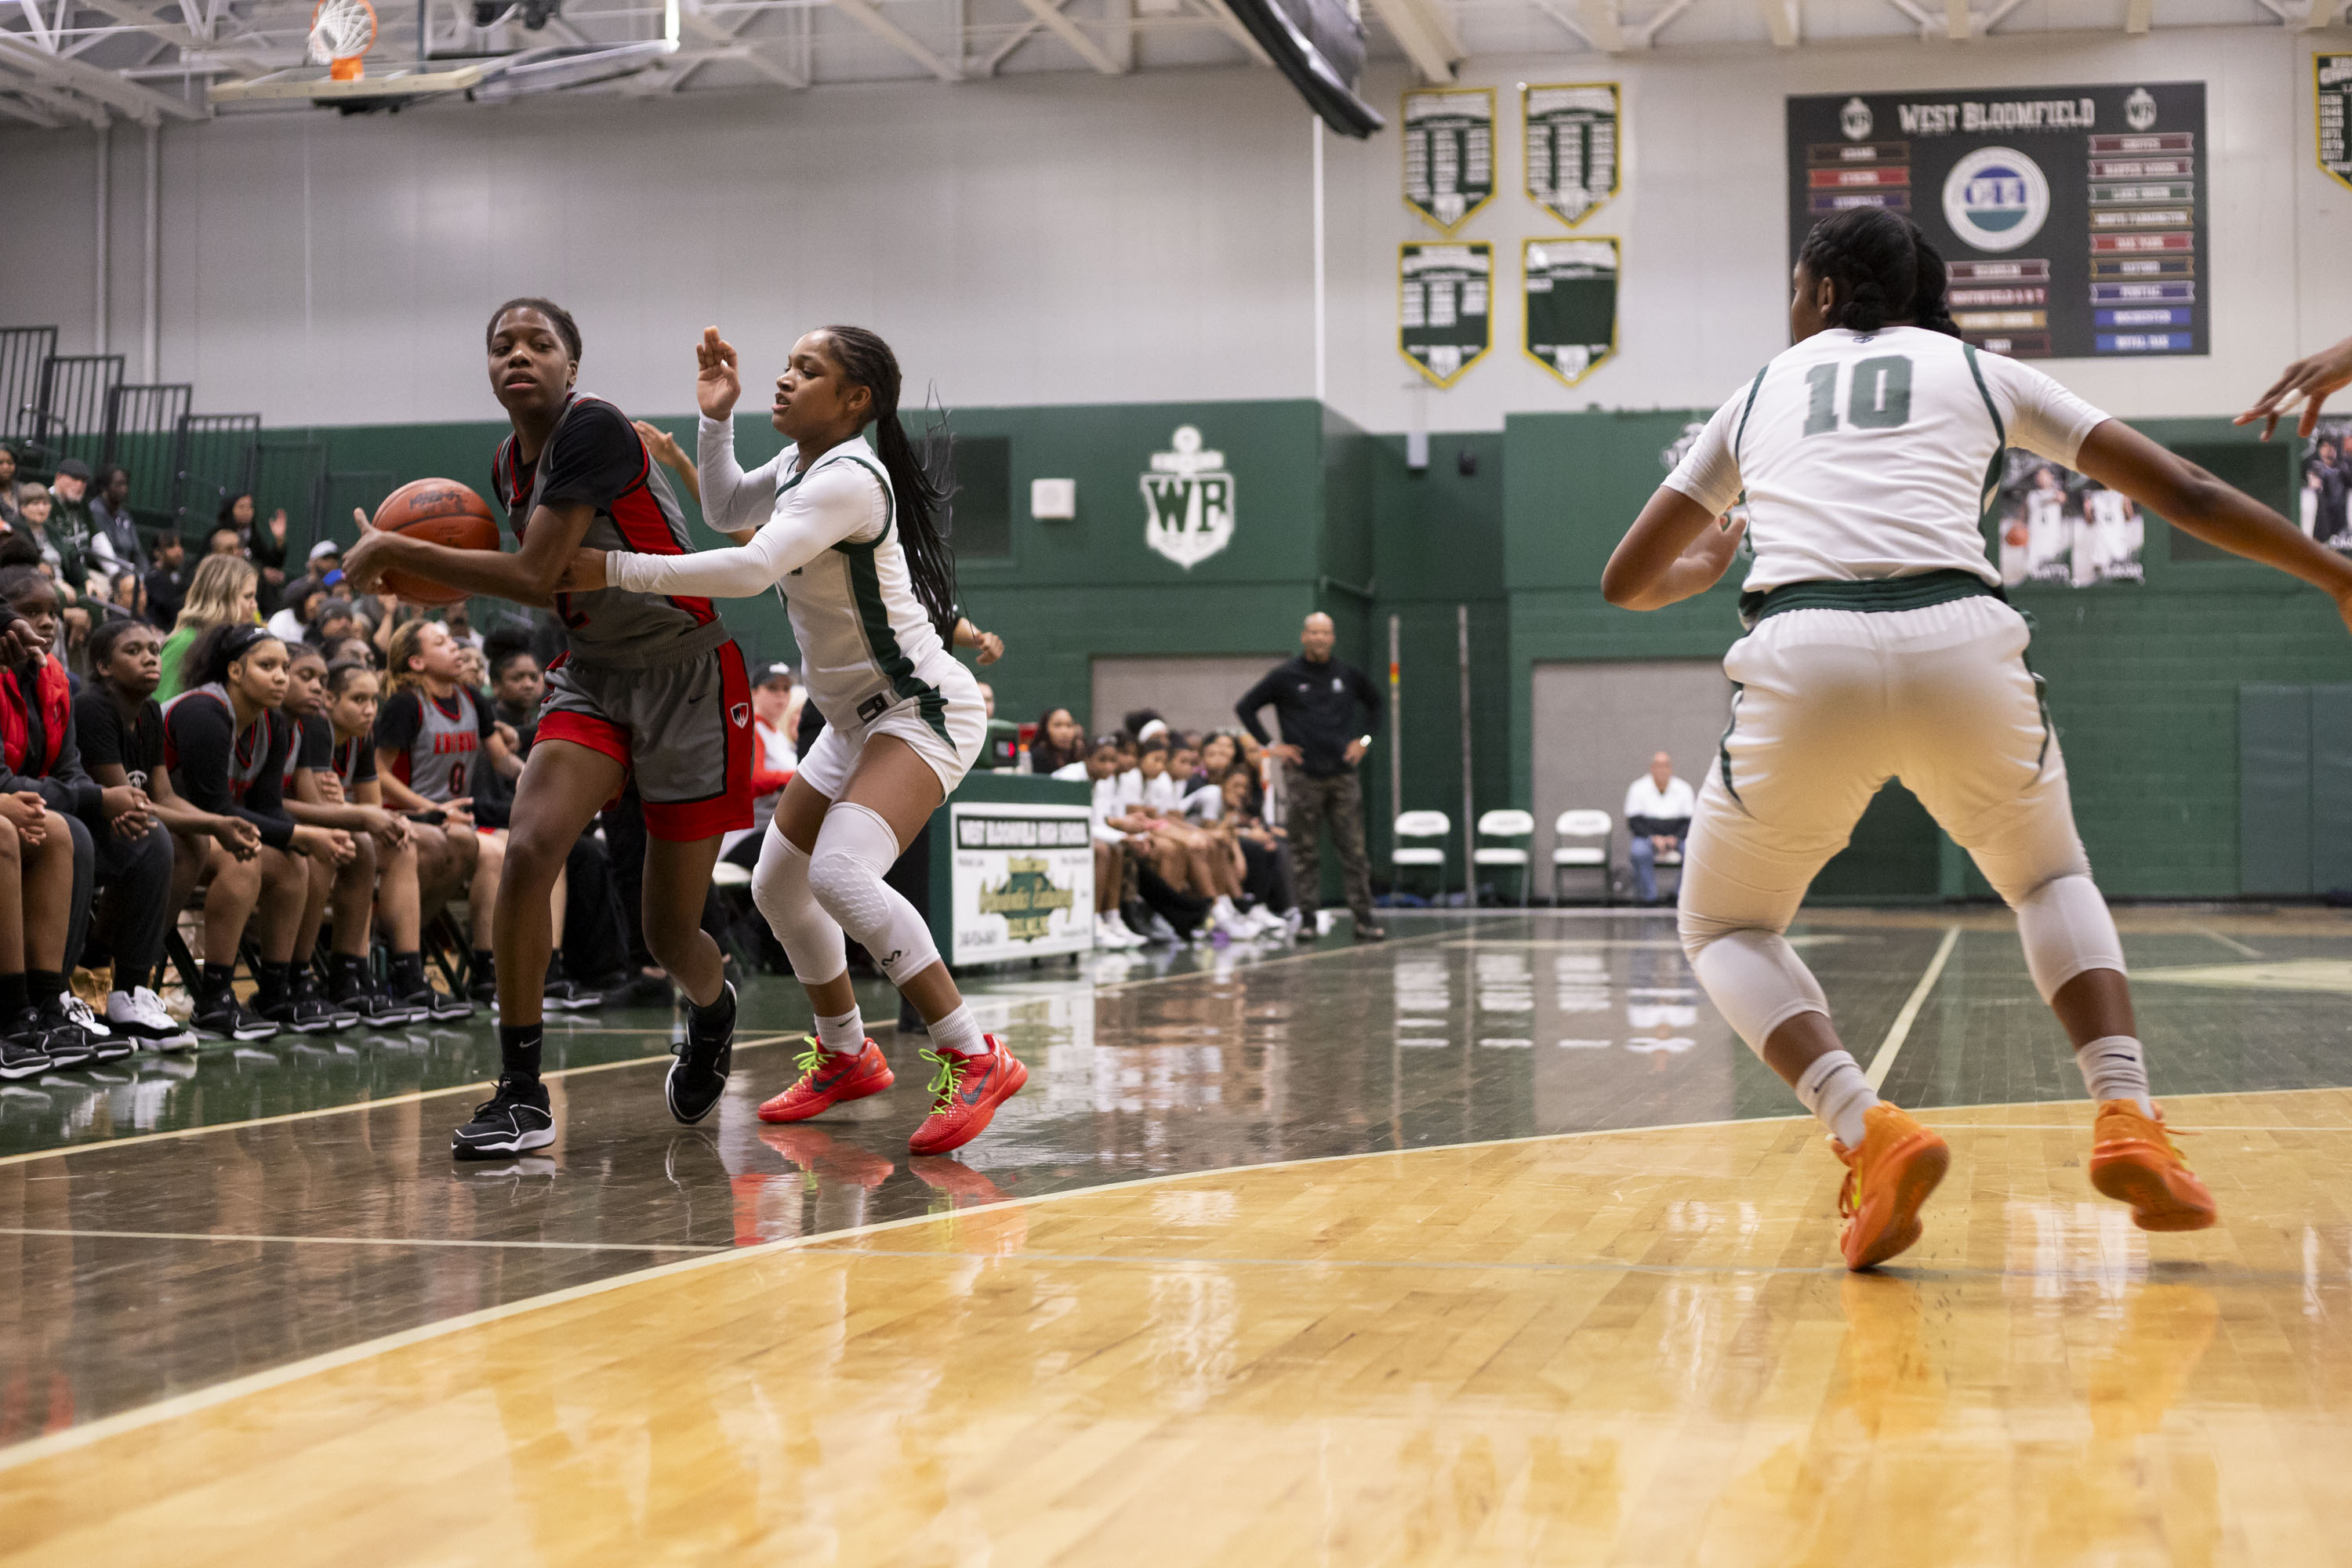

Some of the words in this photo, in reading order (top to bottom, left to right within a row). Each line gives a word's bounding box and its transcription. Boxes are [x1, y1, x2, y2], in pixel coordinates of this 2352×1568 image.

[1897, 104, 1958, 132] WEST
[1962, 98, 2095, 131] BLOOMFIELD
[1802, 355, 1913, 437] 10
[448, 761, 465, 797] 0
